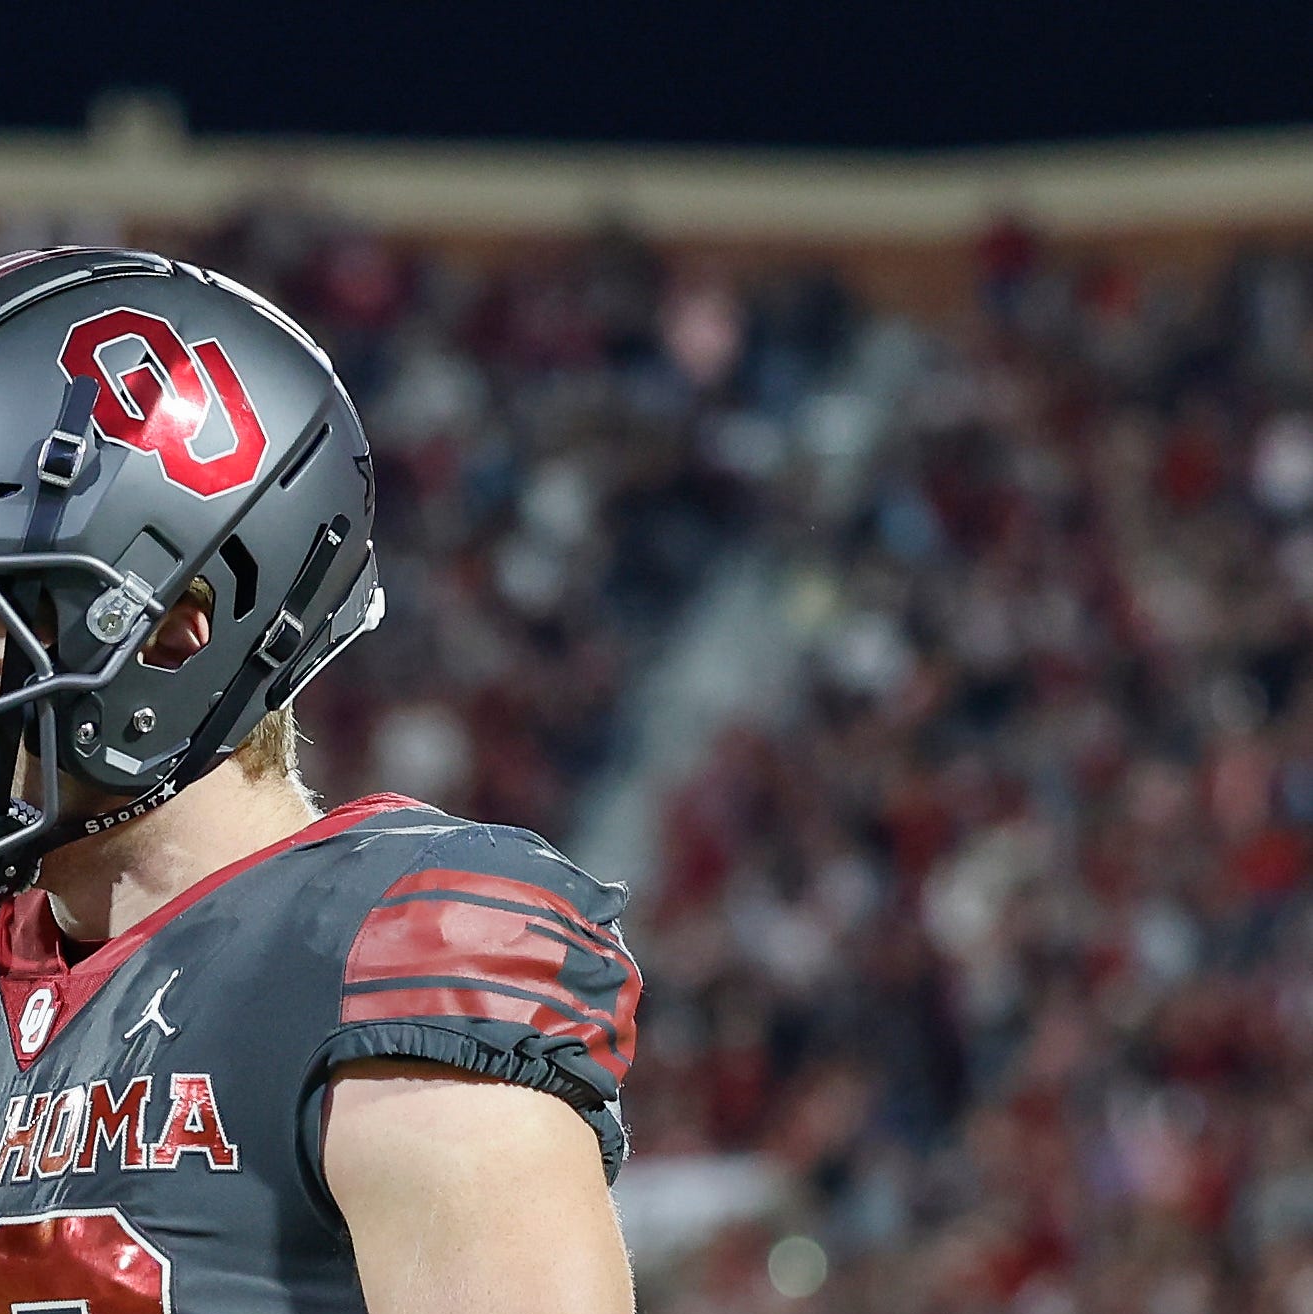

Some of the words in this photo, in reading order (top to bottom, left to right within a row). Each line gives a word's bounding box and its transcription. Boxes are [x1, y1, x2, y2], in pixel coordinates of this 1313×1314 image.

[57, 307, 270, 500] OU
[85, 795, 158, 834] SPORT
[19, 988, 54, 1054] OU
